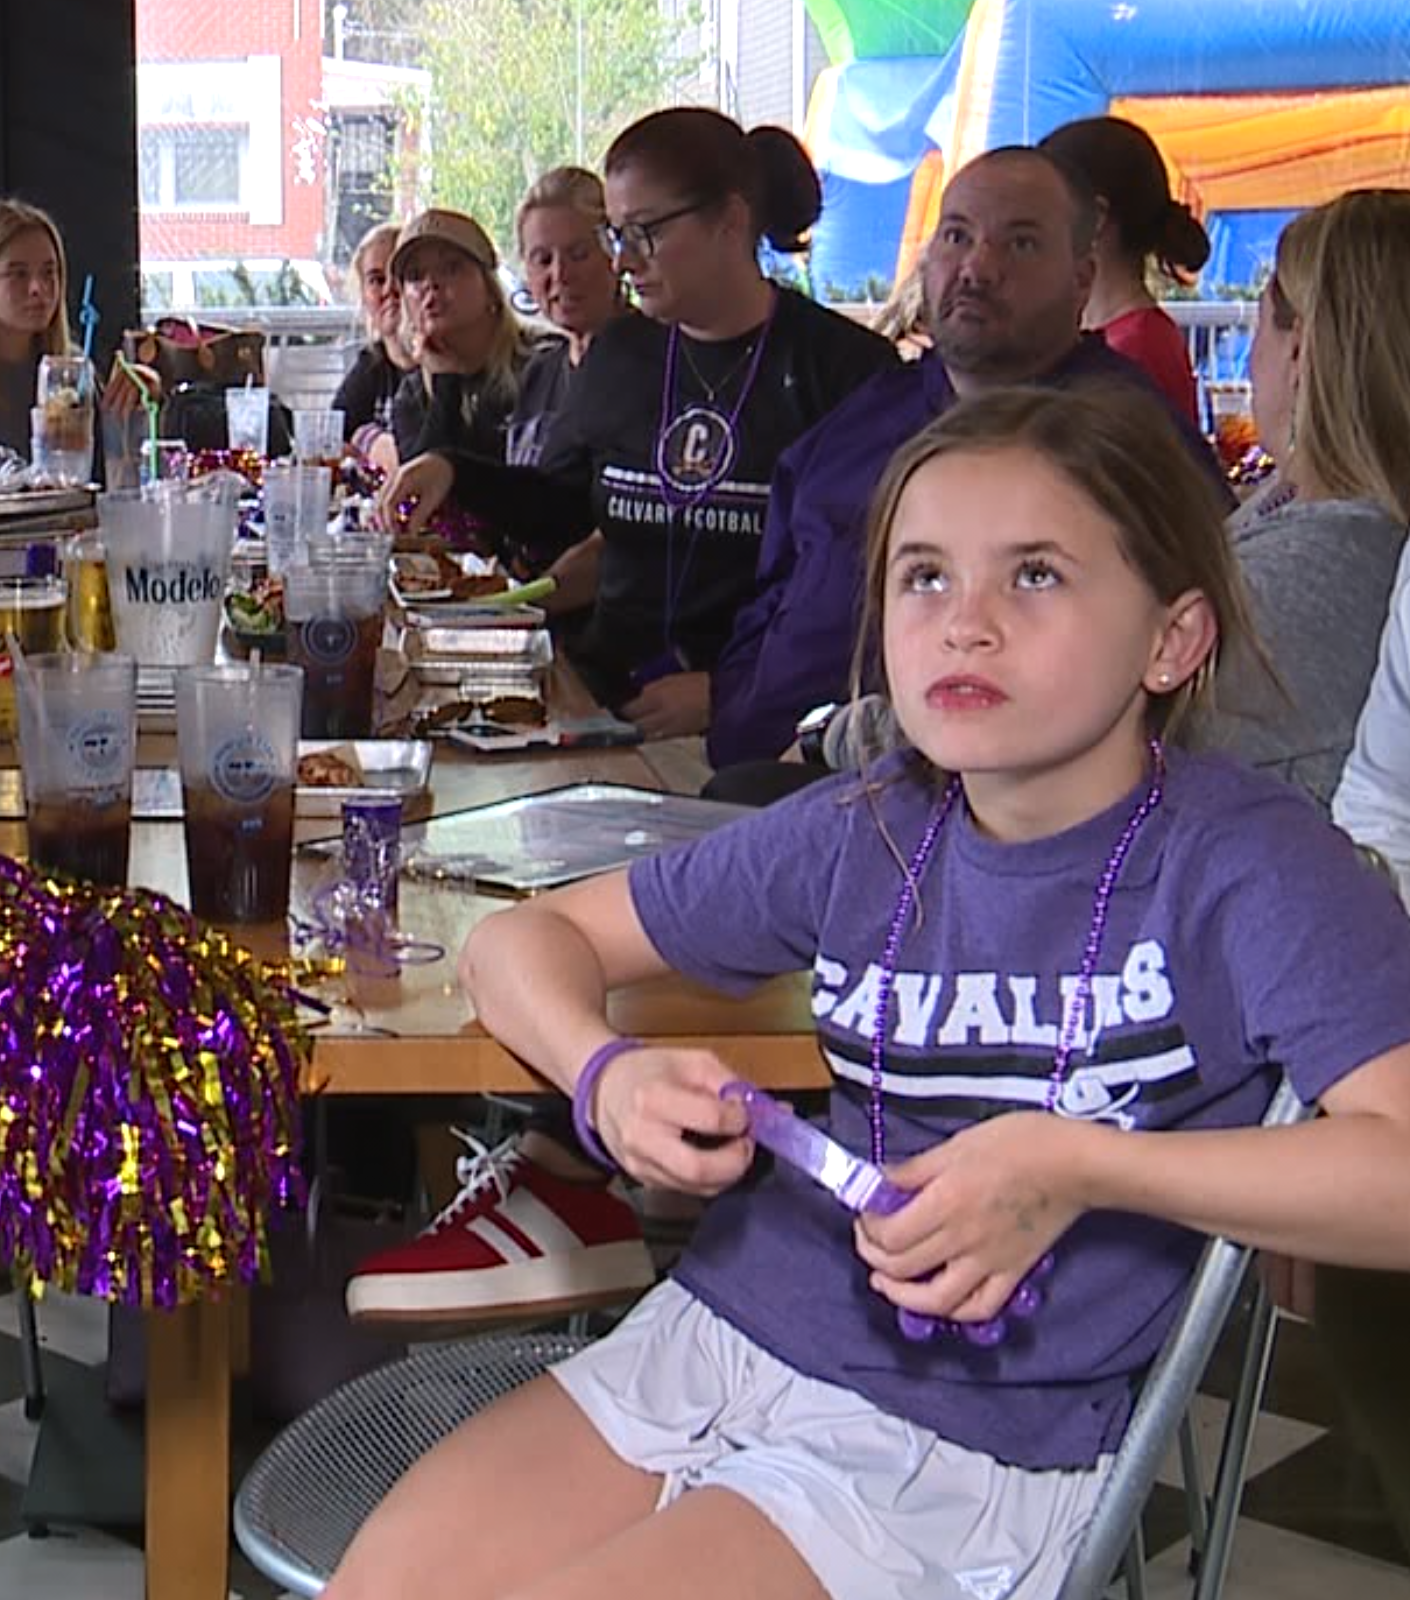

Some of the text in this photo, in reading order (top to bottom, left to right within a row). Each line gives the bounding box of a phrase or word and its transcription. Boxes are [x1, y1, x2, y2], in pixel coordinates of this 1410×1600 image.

[685, 423, 708, 463] C
[607, 495, 763, 535] CALVARY FOOTBAL
[125, 565, 221, 605] Modelo
[811, 939, 1174, 1057] CAVALIS
